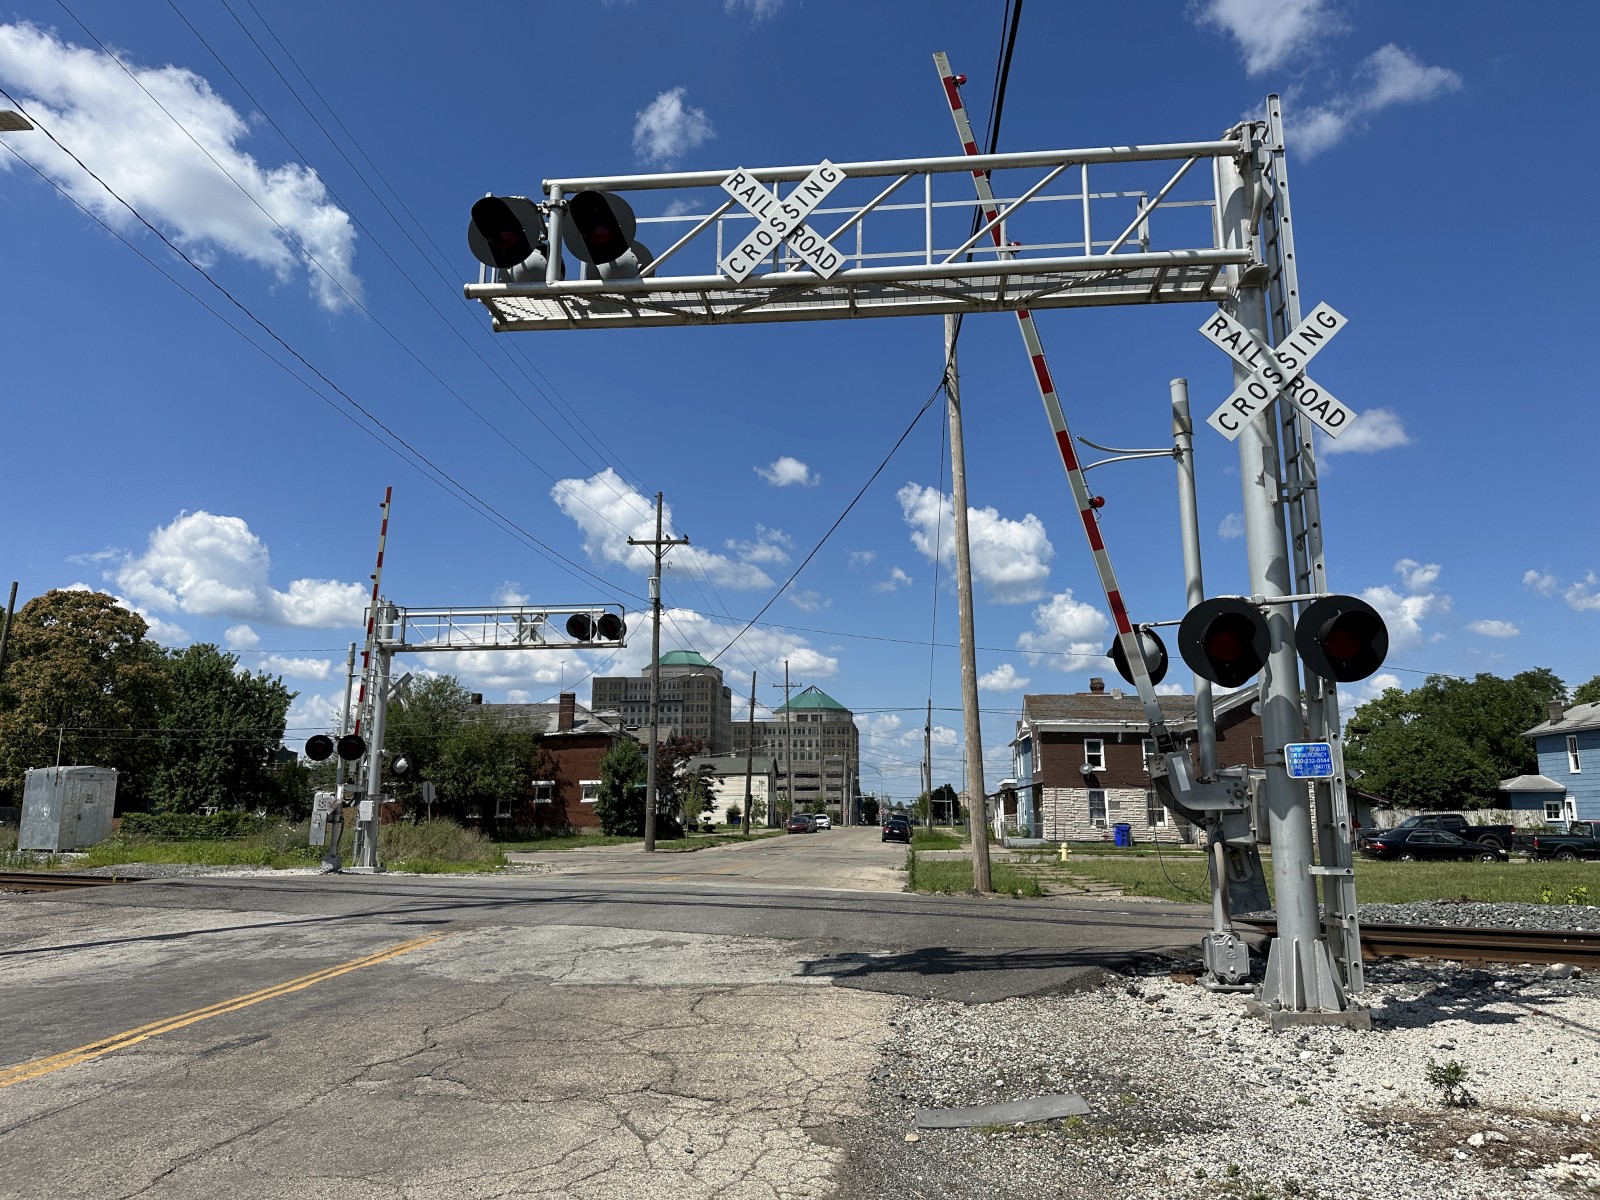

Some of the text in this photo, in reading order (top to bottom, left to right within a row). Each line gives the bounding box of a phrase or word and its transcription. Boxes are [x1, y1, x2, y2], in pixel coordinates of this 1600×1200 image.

[728, 173, 837, 270] RAIL ROAD
[729, 168, 837, 274] CROSSING
[1207, 316, 1346, 428] RAIL ROAD
[1218, 311, 1337, 431] CROSSING
